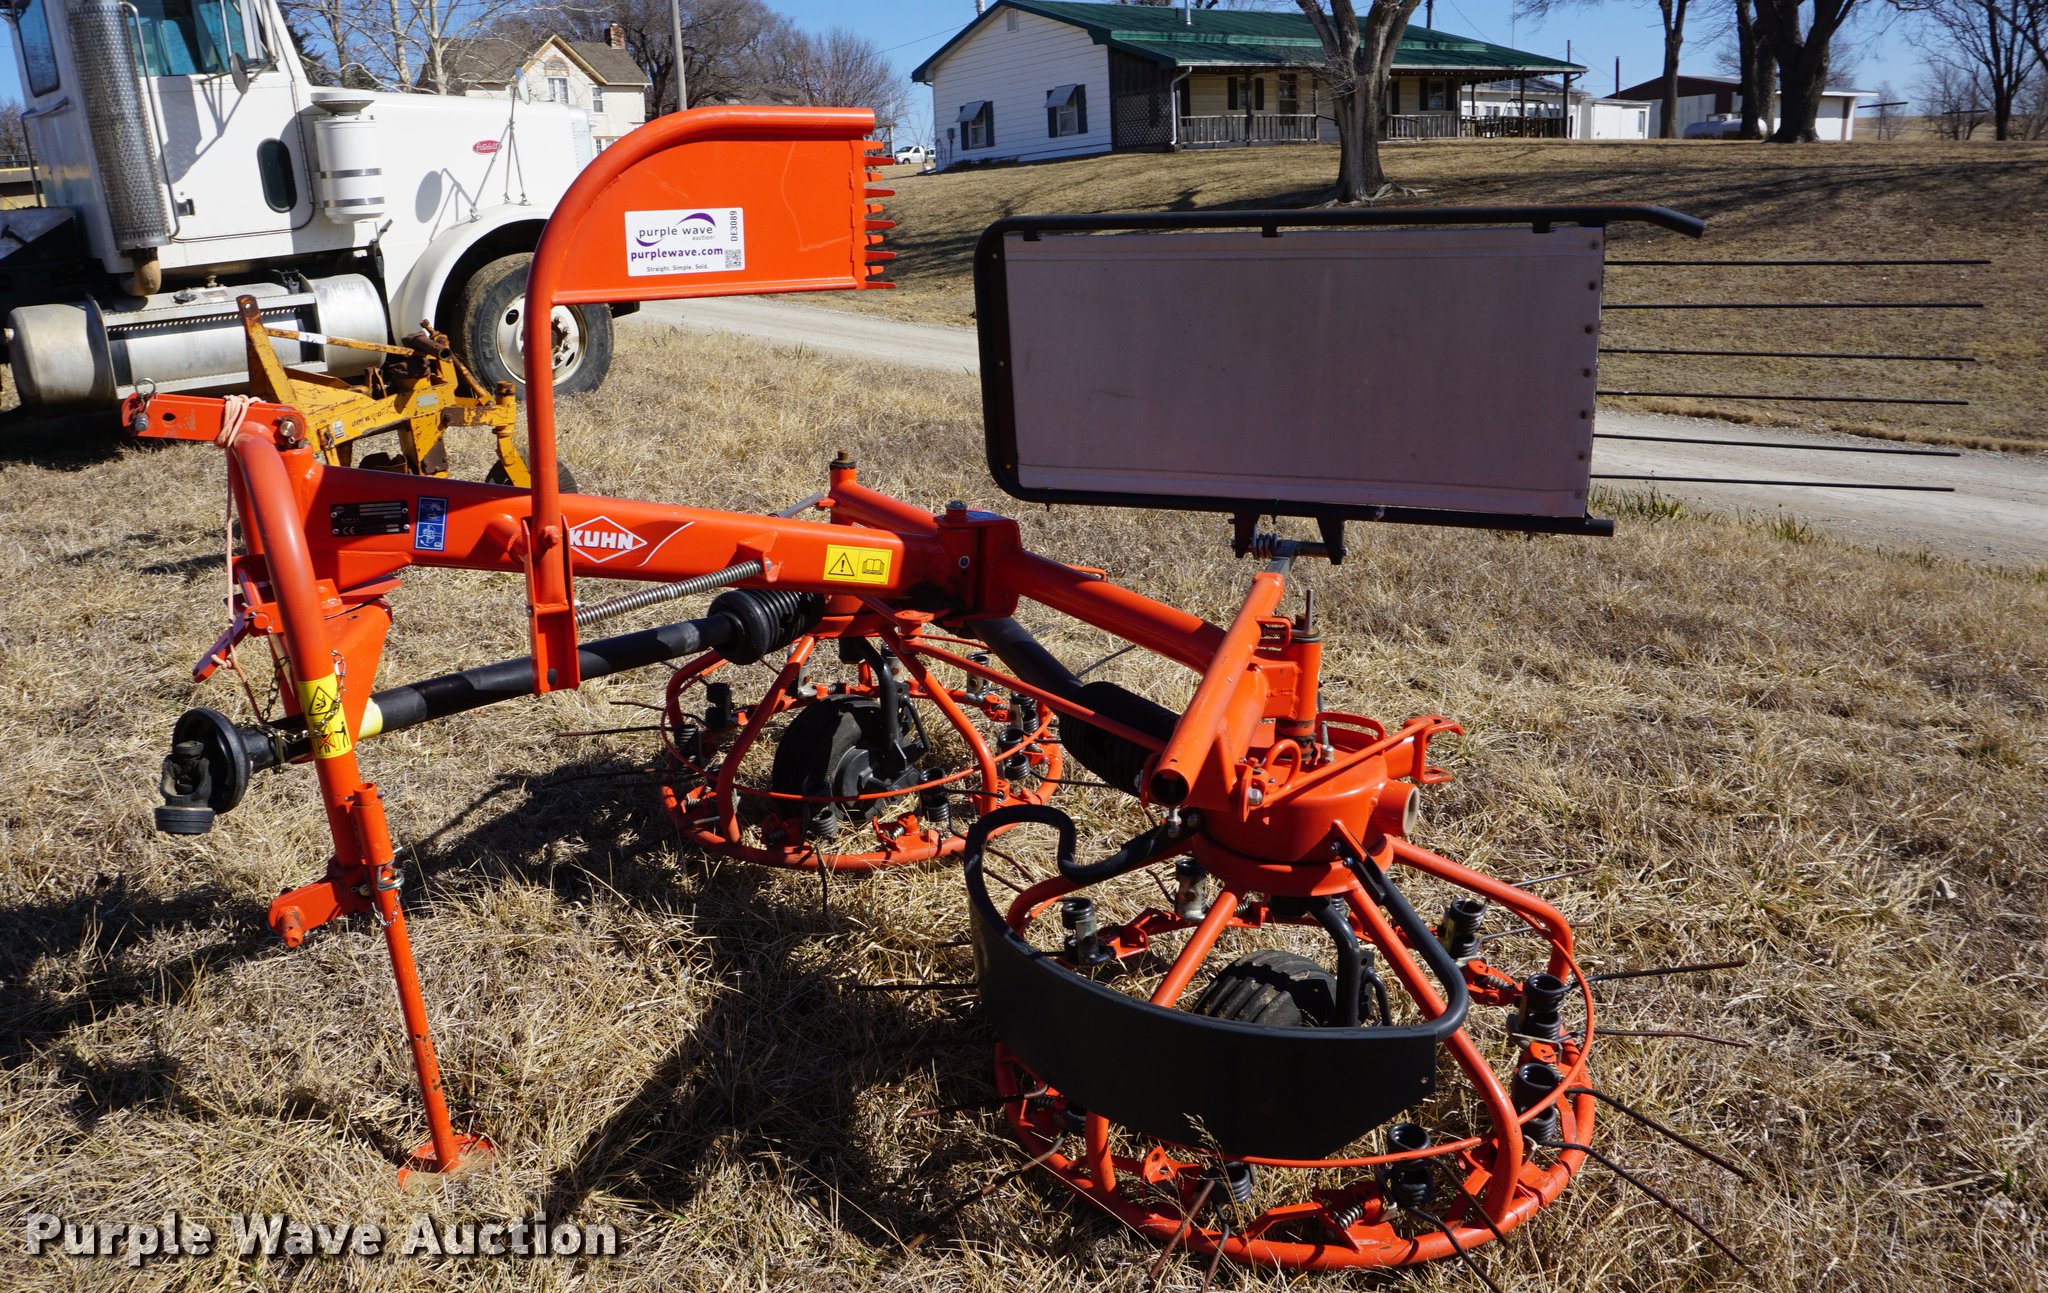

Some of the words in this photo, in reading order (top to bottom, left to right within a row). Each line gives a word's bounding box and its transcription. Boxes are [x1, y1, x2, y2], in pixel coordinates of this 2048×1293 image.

[639, 227, 678, 239] purple
[682, 226, 713, 235] wave
[730, 210, 738, 242] DE3089
[631, 247, 723, 262] purplewave.com
[646, 265, 671, 273] Straight.
[569, 529, 634, 550] KUHN
